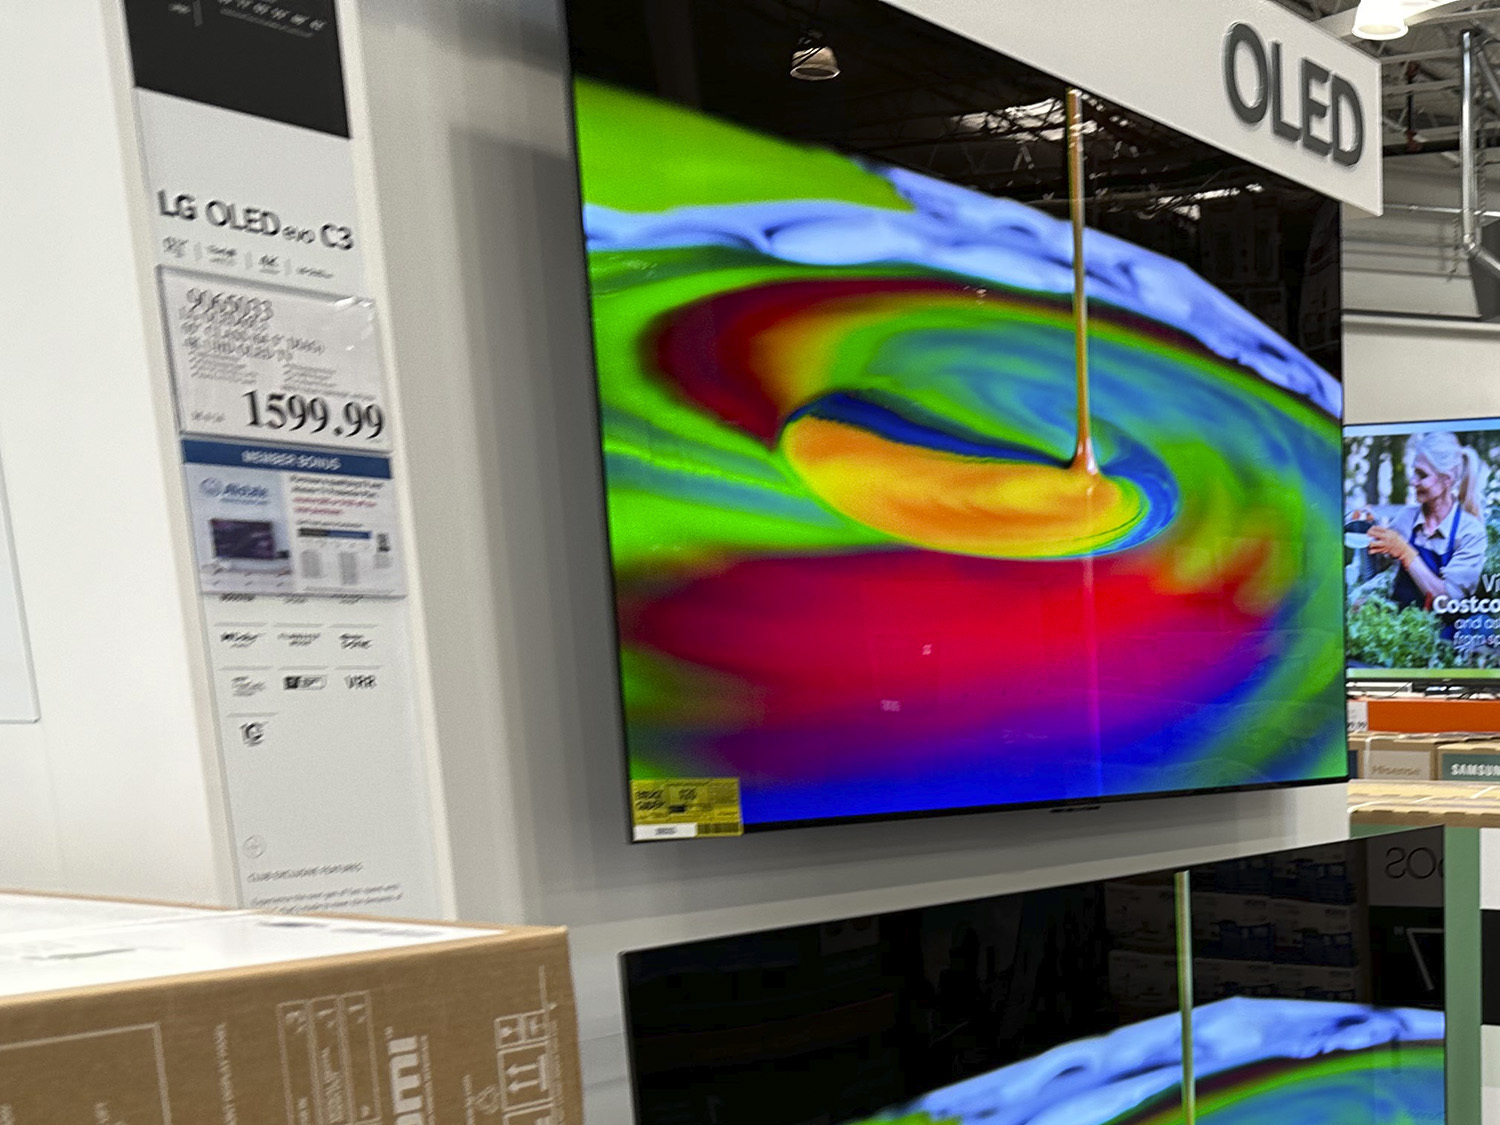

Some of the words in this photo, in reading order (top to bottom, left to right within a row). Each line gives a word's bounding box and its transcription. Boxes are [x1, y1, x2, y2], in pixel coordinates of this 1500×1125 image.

[1223, 22, 1363, 167] OLED
[156, 190, 197, 221] LG
[205, 200, 281, 236] OLED
[320, 223, 354, 250] C3
[242, 389, 385, 439] 1599.99
[1453, 632, 1486, 648] from
[1454, 616, 1482, 630] and
